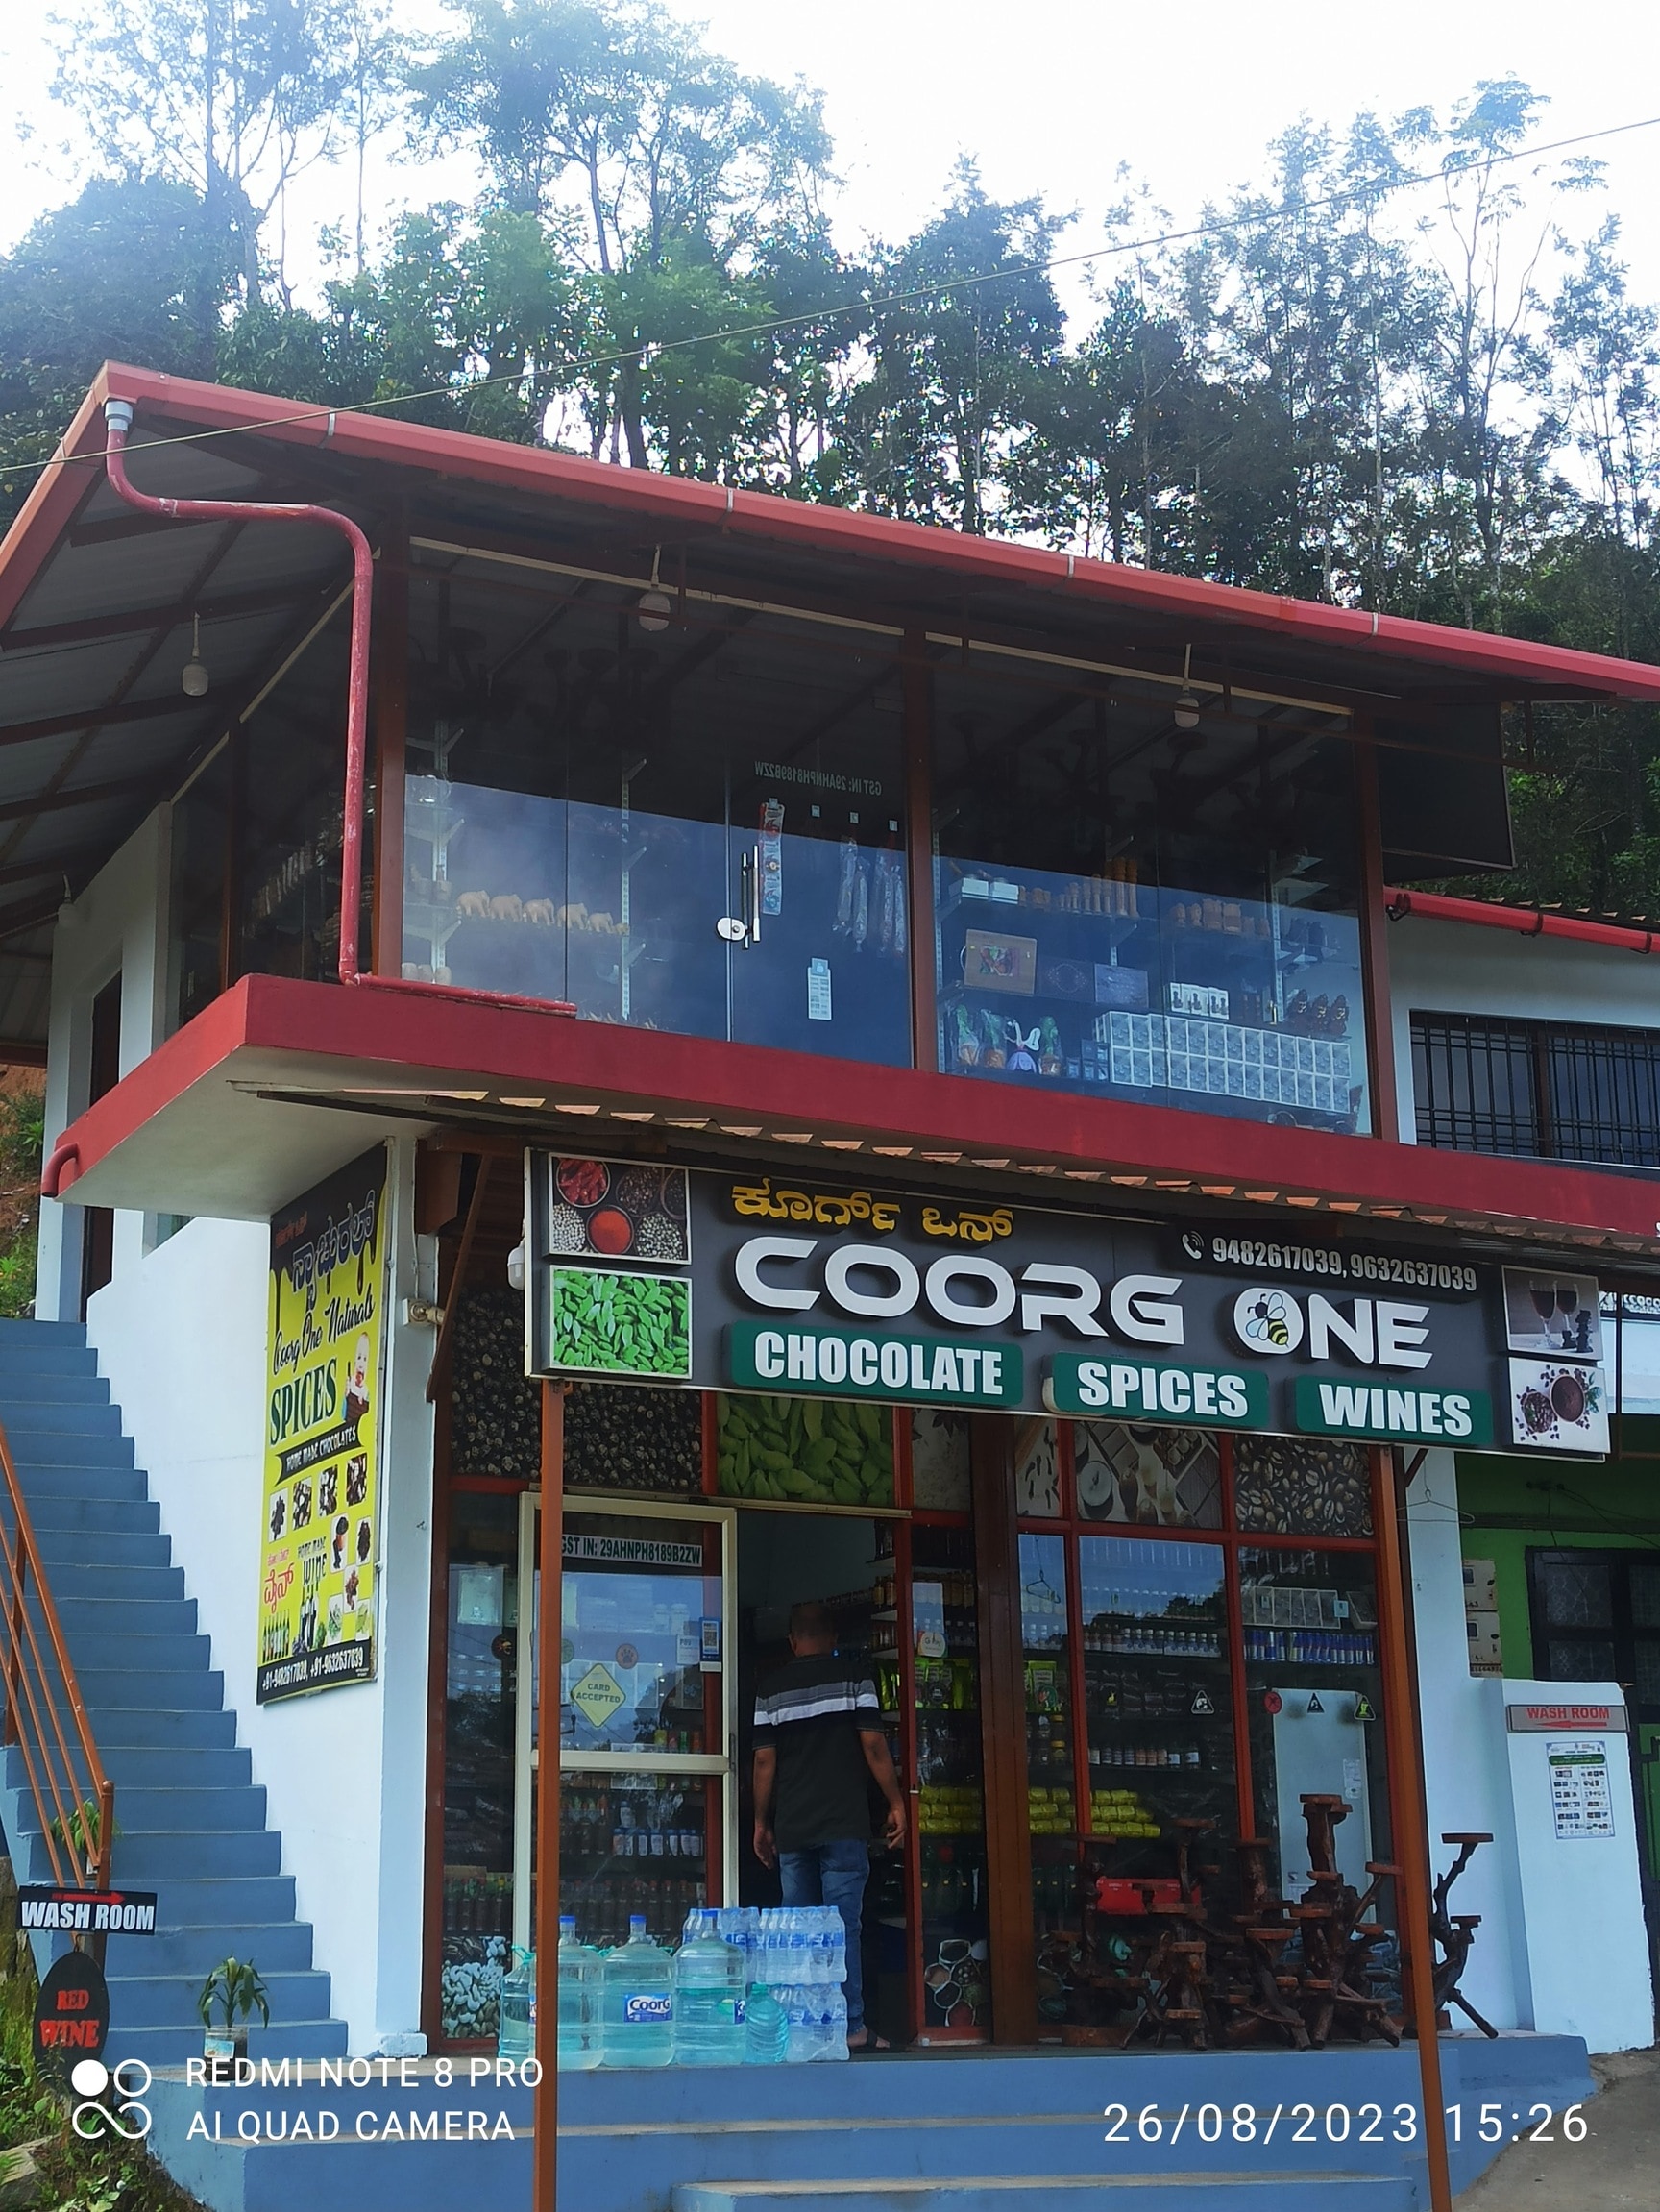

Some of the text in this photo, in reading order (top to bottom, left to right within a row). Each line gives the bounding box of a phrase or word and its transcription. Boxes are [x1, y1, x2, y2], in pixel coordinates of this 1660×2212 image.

[732, 1178, 1013, 1241] ಕೂರ್ಗ್ ಒನ್
[1212, 1237, 1477, 1291] 9482617039, 9632637039
[274, 1283, 375, 1375] Coorg One Naturals
[735, 1236, 1433, 1369] COORG ONE
[754, 1331, 1003, 1395] CHOCOLATE
[1078, 1361, 1249, 1419] SPICES
[270, 1358, 337, 1445] SPICES
[1318, 1383, 1473, 1437] WINES
[583, 1537, 598, 1556] IN:
[600, 1539, 700, 1564] 29AHNPH8189B2ZW
[575, 1692, 621, 1703] ACCEPTED
[588, 1683, 611, 1691] CARD
[1526, 1707, 1610, 1720] WASH ROOM
[21, 1901, 154, 1930] WASH ROOM
[57, 1990, 89, 2011] RED
[40, 2020, 100, 2048] WINE
